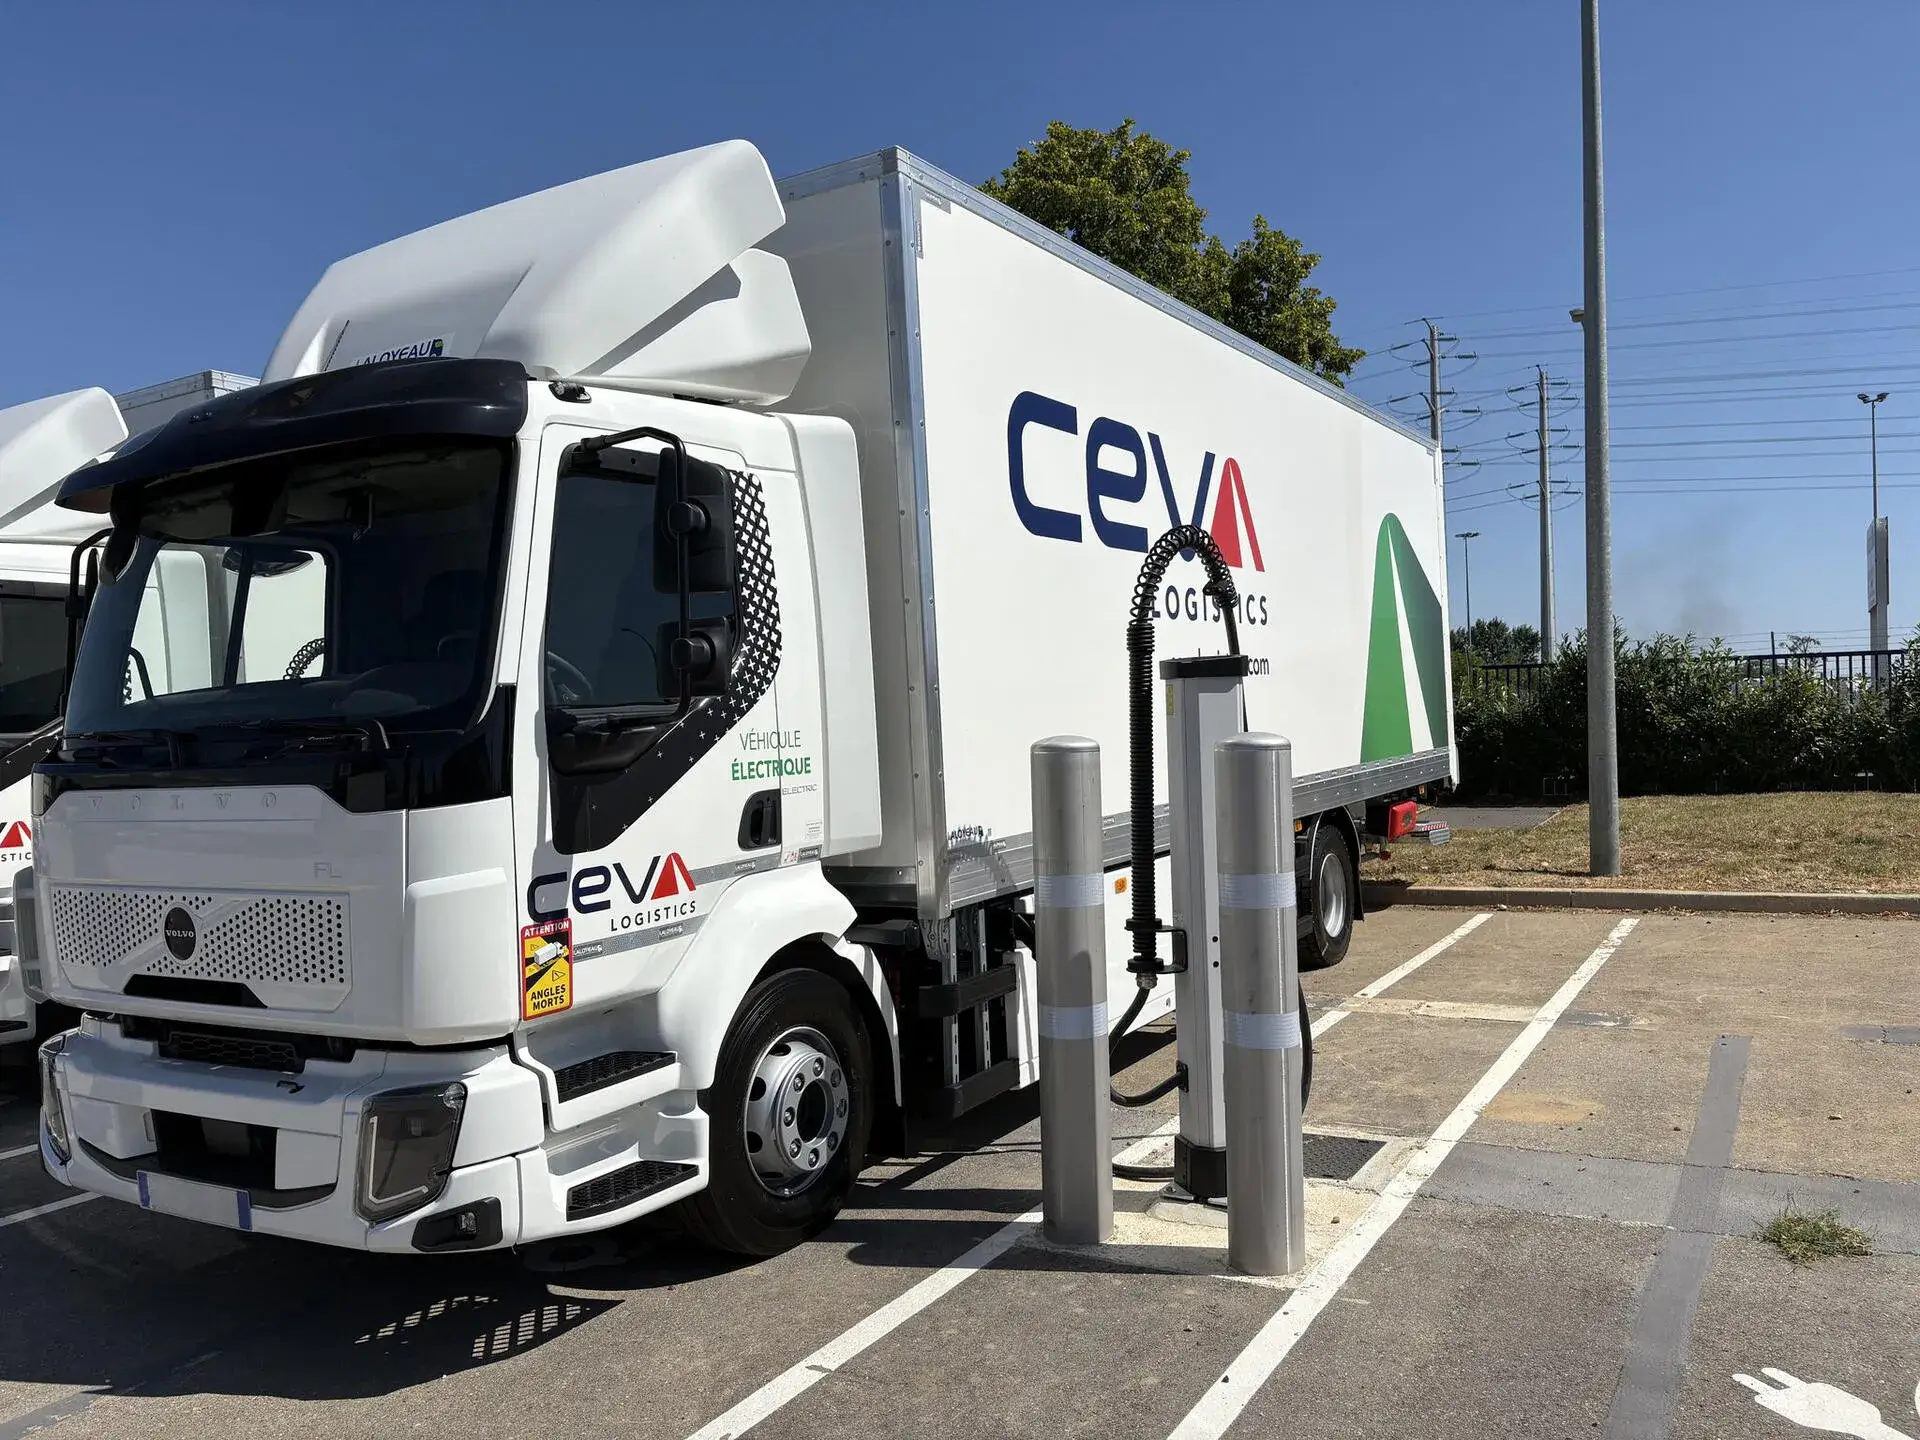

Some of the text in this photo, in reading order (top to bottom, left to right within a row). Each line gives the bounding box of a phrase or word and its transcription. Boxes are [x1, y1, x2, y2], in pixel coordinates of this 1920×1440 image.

[1151, 585, 1267, 625] LOGISICS
[740, 728, 802, 751] VÉHICULE
[731, 758, 811, 781] ÉLECTRIQUE
[782, 784, 817, 796] ELECTRIC
[88, 792, 277, 811] VOLVO
[313, 862, 342, 879] FL
[610, 900, 697, 932] LOGISTICS
[166, 930, 194, 938] VOLVO
[524, 921, 569, 938] ATTENTION
[530, 984, 566, 1002] ANGLES
[532, 995, 565, 1012] MORTS
